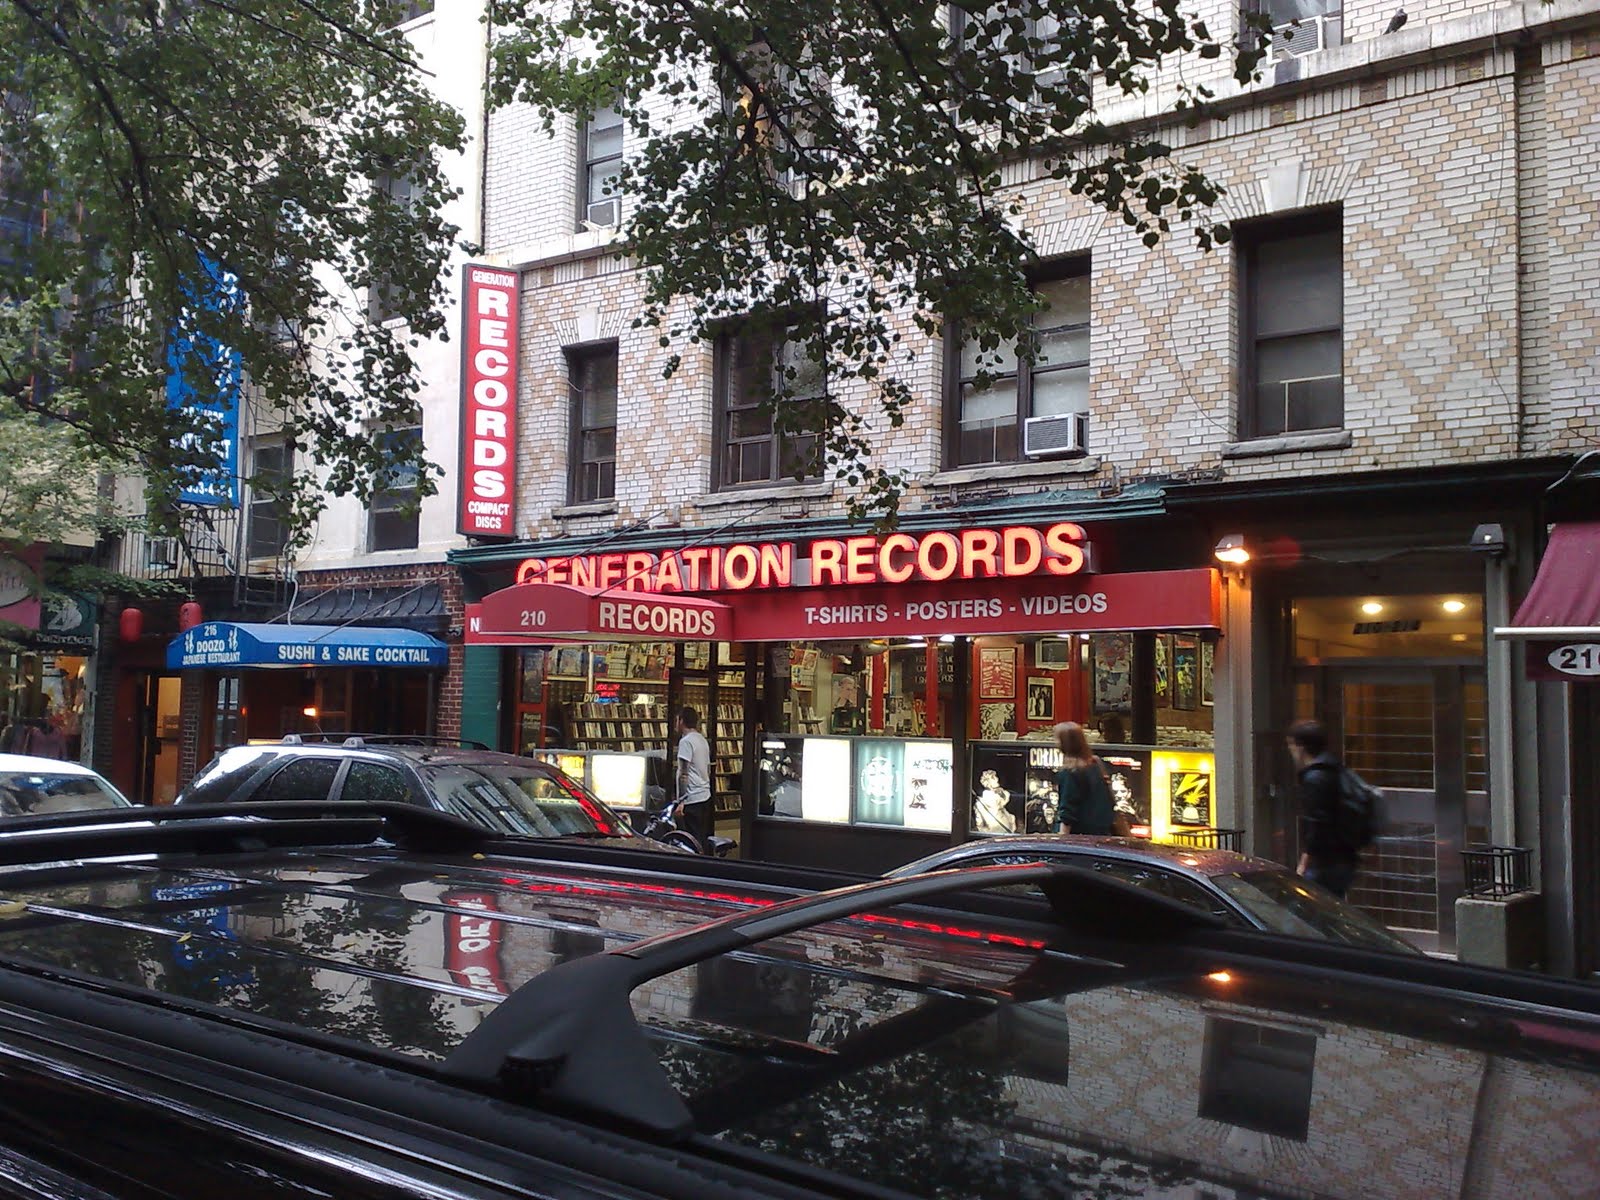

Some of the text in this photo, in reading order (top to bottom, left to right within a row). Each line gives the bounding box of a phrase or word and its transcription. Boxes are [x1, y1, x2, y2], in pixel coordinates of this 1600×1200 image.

[472, 270, 515, 288] GENERATION
[473, 288, 509, 498] RECORDS
[468, 501, 510, 516] COMPACT
[475, 514, 502, 529] DISCS
[516, 522, 1086, 593] GENERATION RECORDS
[805, 604, 888, 625] T-SHIRTS
[905, 599, 1002, 621] POSTERS
[1022, 593, 1108, 616] VIDEOS
[521, 610, 546, 626] 210
[599, 601, 716, 636] RECORDS
[196, 639, 225, 653] DOOZO
[278, 645, 430, 662] SUSHI & SAKE COCKTAIL
[208, 652, 240, 663] RESTAURANT
[1560, 648, 1600, 669] 21
